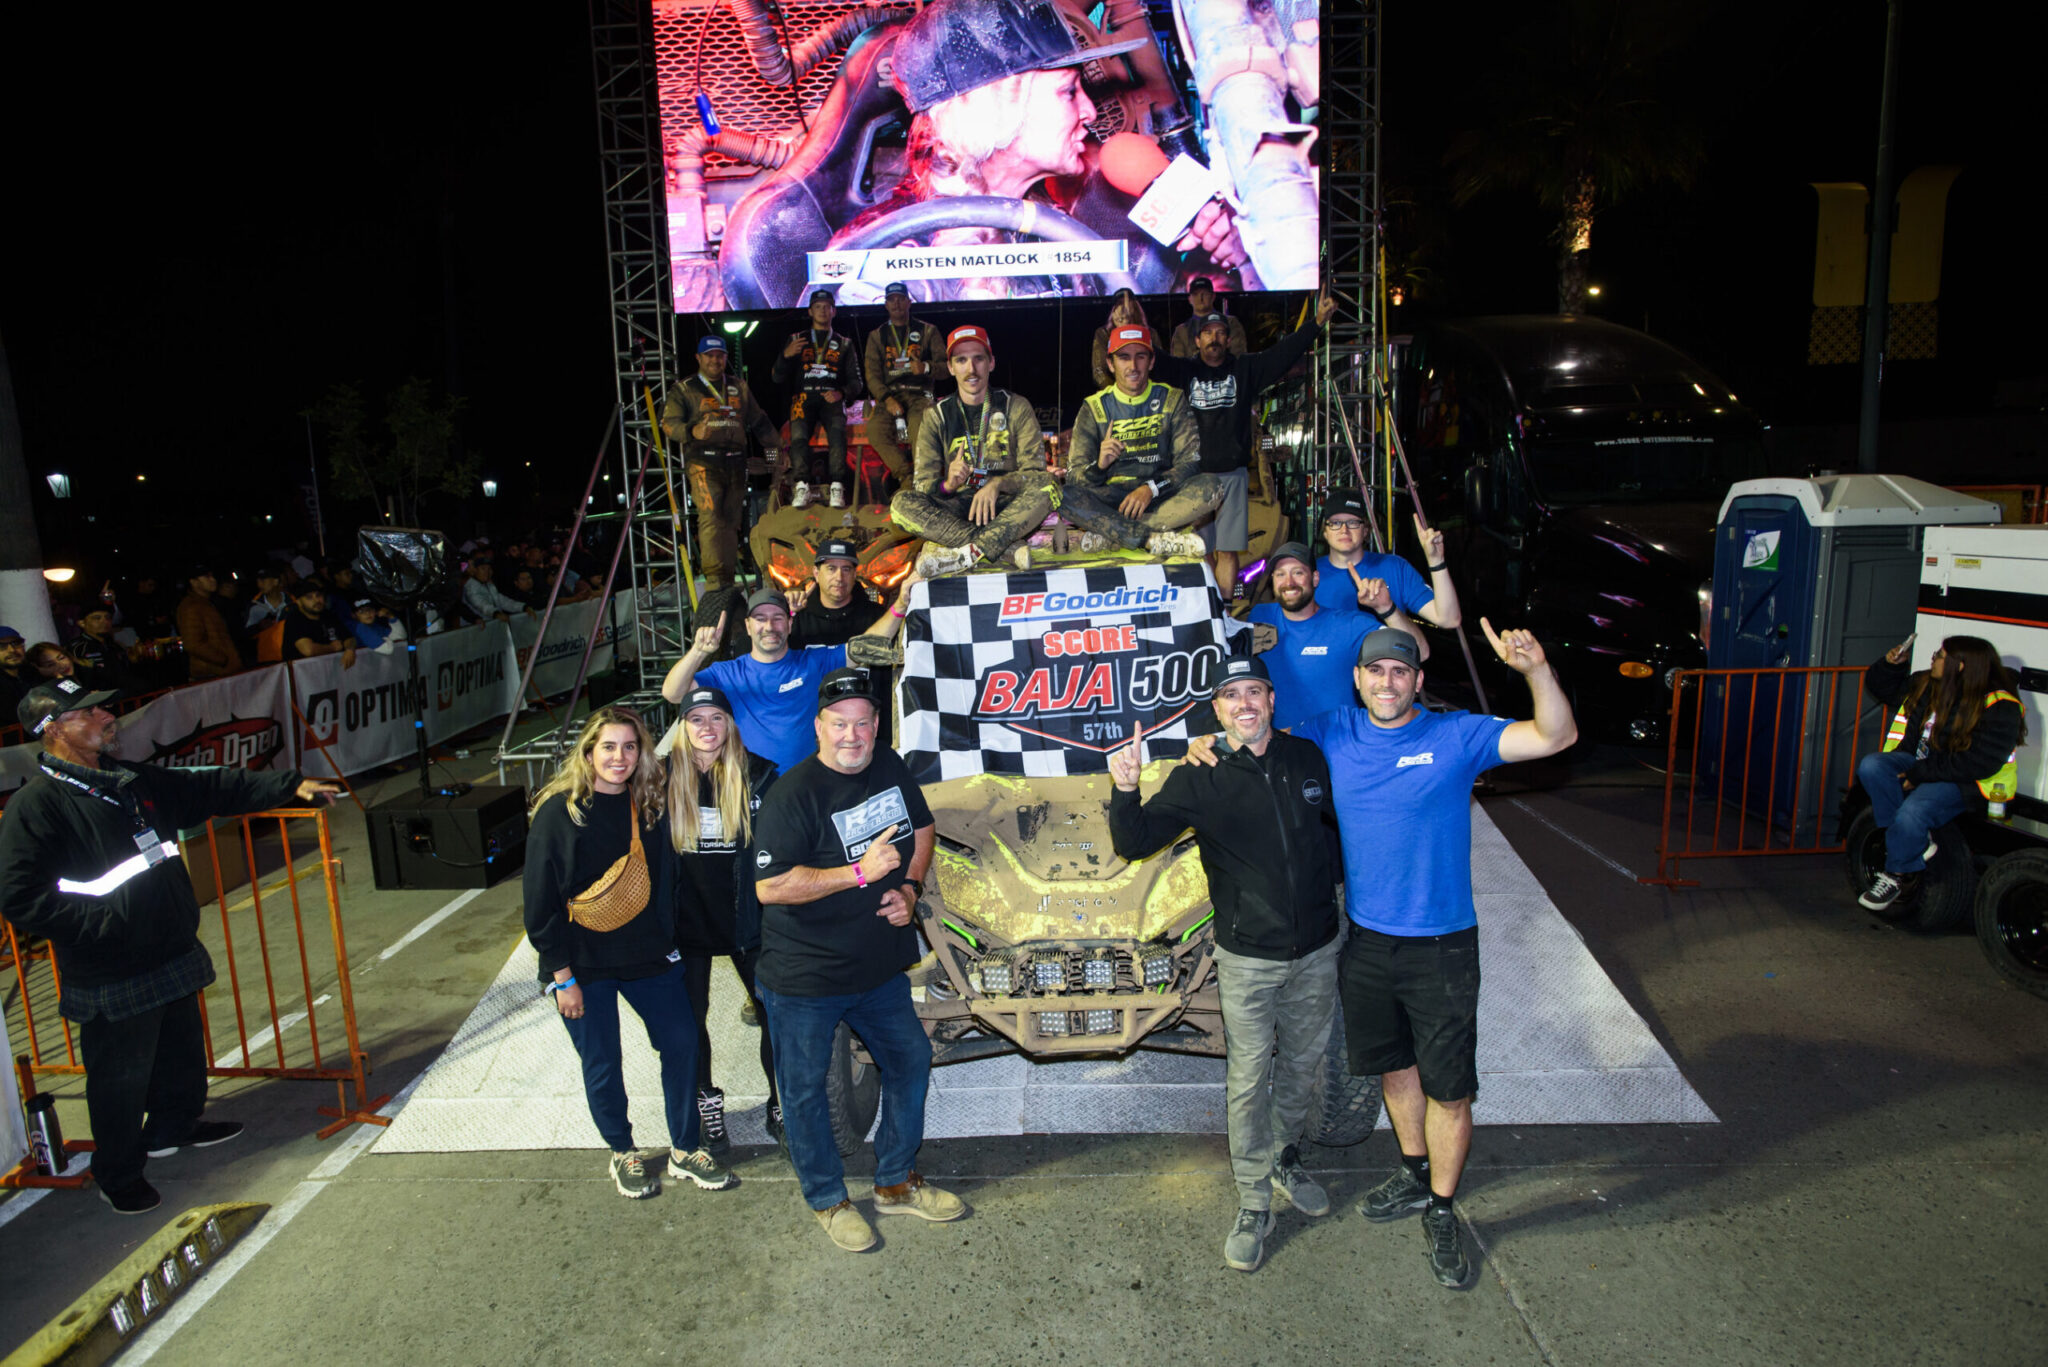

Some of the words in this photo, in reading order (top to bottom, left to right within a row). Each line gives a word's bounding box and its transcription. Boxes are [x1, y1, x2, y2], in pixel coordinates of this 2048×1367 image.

[886, 257, 956, 270] KRISTEN
[961, 253, 1039, 266] MATLOCK
[1001, 584, 1179, 617] BFGoodrich
[1043, 625, 1138, 658] SCORE
[456, 653, 504, 697] OPTIMA
[978, 662, 1115, 714] BAJA
[1130, 643, 1222, 707] 500
[345, 675, 429, 732] OPTIMA
[222, 724, 279, 768] Open
[1083, 721, 1124, 741] 57th
